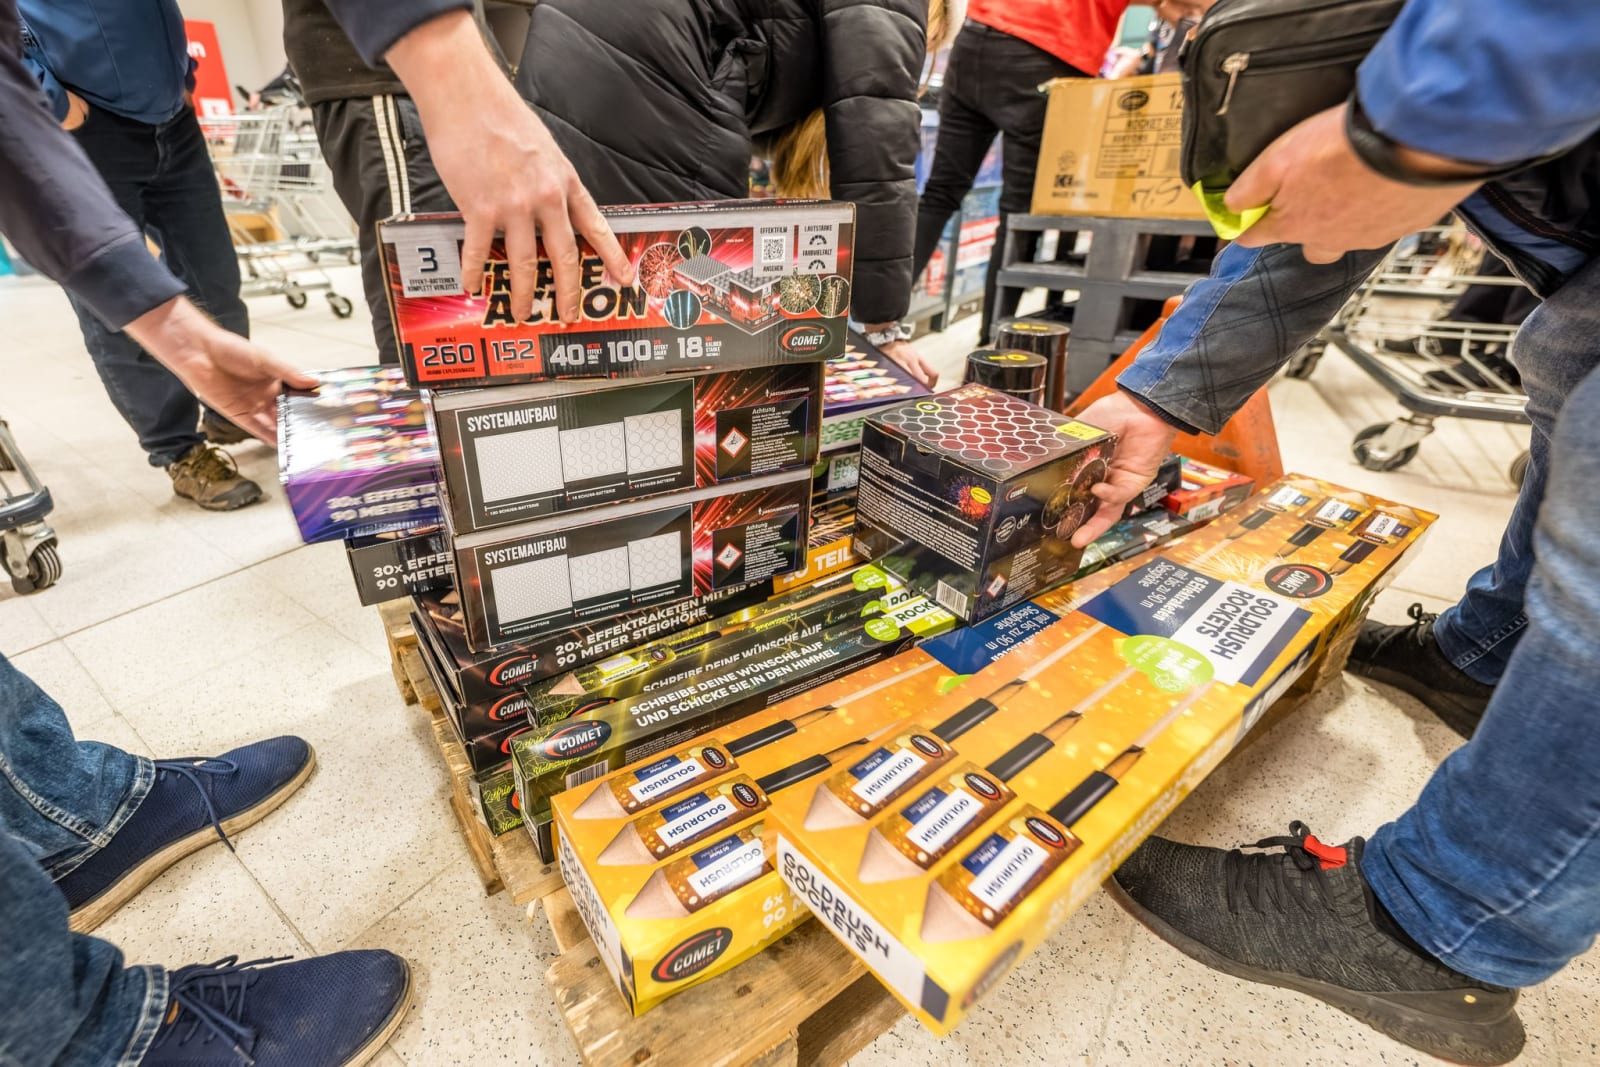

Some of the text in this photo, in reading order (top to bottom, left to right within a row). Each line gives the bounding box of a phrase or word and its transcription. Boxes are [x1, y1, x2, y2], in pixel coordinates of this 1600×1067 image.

[760, 226, 788, 234] EFFEKTFILM
[418, 247, 438, 272] 3
[491, 339, 535, 361] 152
[607, 340, 651, 363] 100
[677, 336, 703, 358] 18
[791, 335, 825, 346] COMET
[421, 343, 475, 367] 260
[550, 343, 585, 366] 40
[467, 405, 557, 432] SYSTEMAUFBAU
[752, 407, 776, 415] Achtung
[484, 536, 567, 565] SYSTEMAUFBAU
[373, 552, 452, 578] 30x EFFE
[376, 577, 397, 590] 90
[1277, 570, 1311, 594] COMET
[555, 641, 583, 656] 20x
[586, 599, 699, 644] EFFEKTRAKETEN
[703, 590, 723, 604] MIT
[895, 600, 938, 622] ROCK
[994, 605, 1040, 630] Steighöhe
[1196, 588, 1255, 638] ROCKETS
[557, 607, 707, 667] 90 METER STEIGHÖHE
[801, 623, 822, 638] AUF
[985, 613, 1050, 650] mit bis zu 90 m
[1210, 598, 1278, 660] GOLDRUSH
[501, 659, 539, 681] COMET
[629, 641, 824, 716] SCHREIBE DEINE WÜNSCHE AUF
[636, 647, 840, 727] UND SCHICKE SIE IN DEN HIMMEL
[500, 699, 529, 716] COM
[559, 726, 602, 751] COMET
[705, 749, 722, 765] COMET
[639, 764, 696, 795] GOLDRUSH
[865, 756, 913, 796] GOLDRUSH
[736, 785, 753, 804] COMET
[667, 803, 727, 838] GOLDRUSH
[921, 798, 970, 842] GOLDRUSH
[700, 848, 762, 888] GOLDRUSH
[984, 845, 1033, 897] GOLDRUSH
[762, 893, 784, 912] 6x
[784, 851, 890, 960] GOLDRUSH
[784, 867, 868, 953] ROCKETS
[763, 906, 786, 929] 90
[673, 936, 724, 973] COMET
